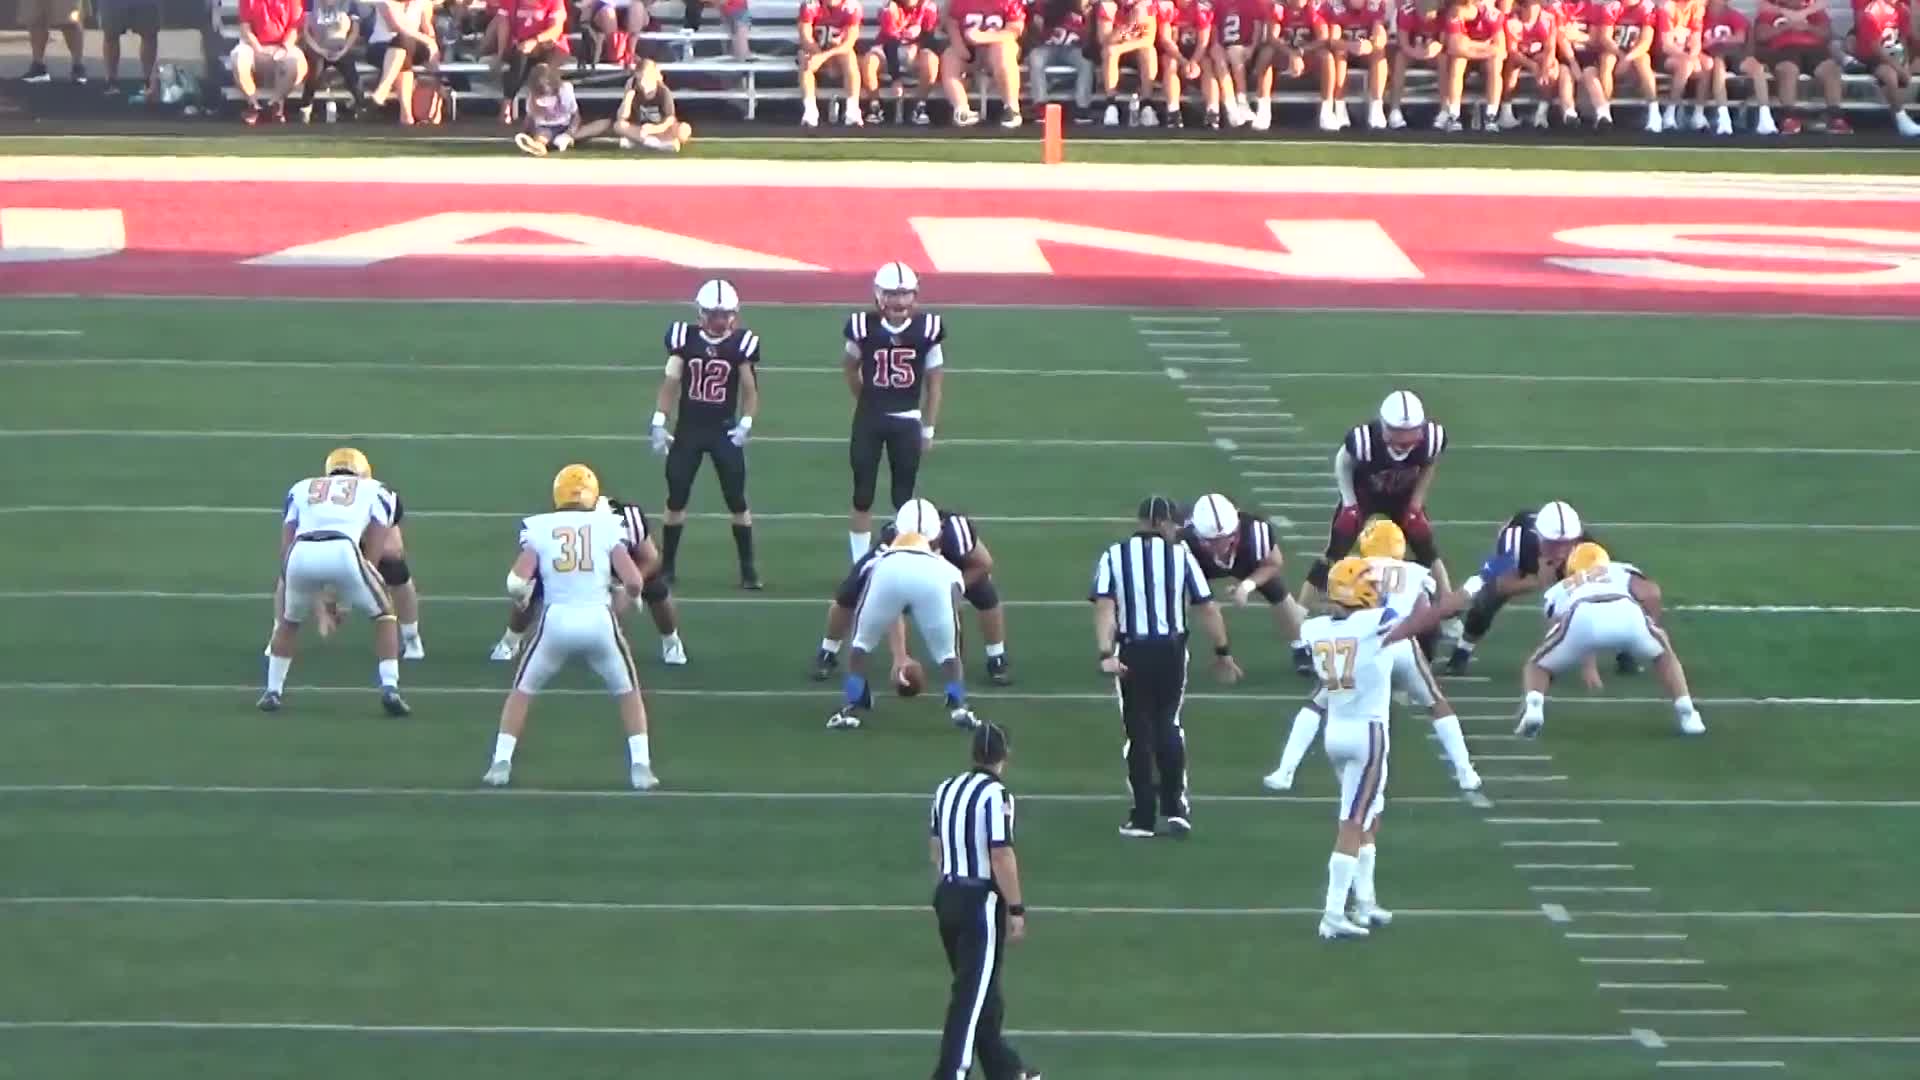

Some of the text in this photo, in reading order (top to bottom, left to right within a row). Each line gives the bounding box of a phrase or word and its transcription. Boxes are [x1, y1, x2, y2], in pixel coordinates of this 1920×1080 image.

[688, 358, 731, 402] 12
[873, 349, 917, 387] 15
[308, 479, 358, 506] 93
[552, 524, 594, 572] 31
[1312, 637, 1357, 690] 37
